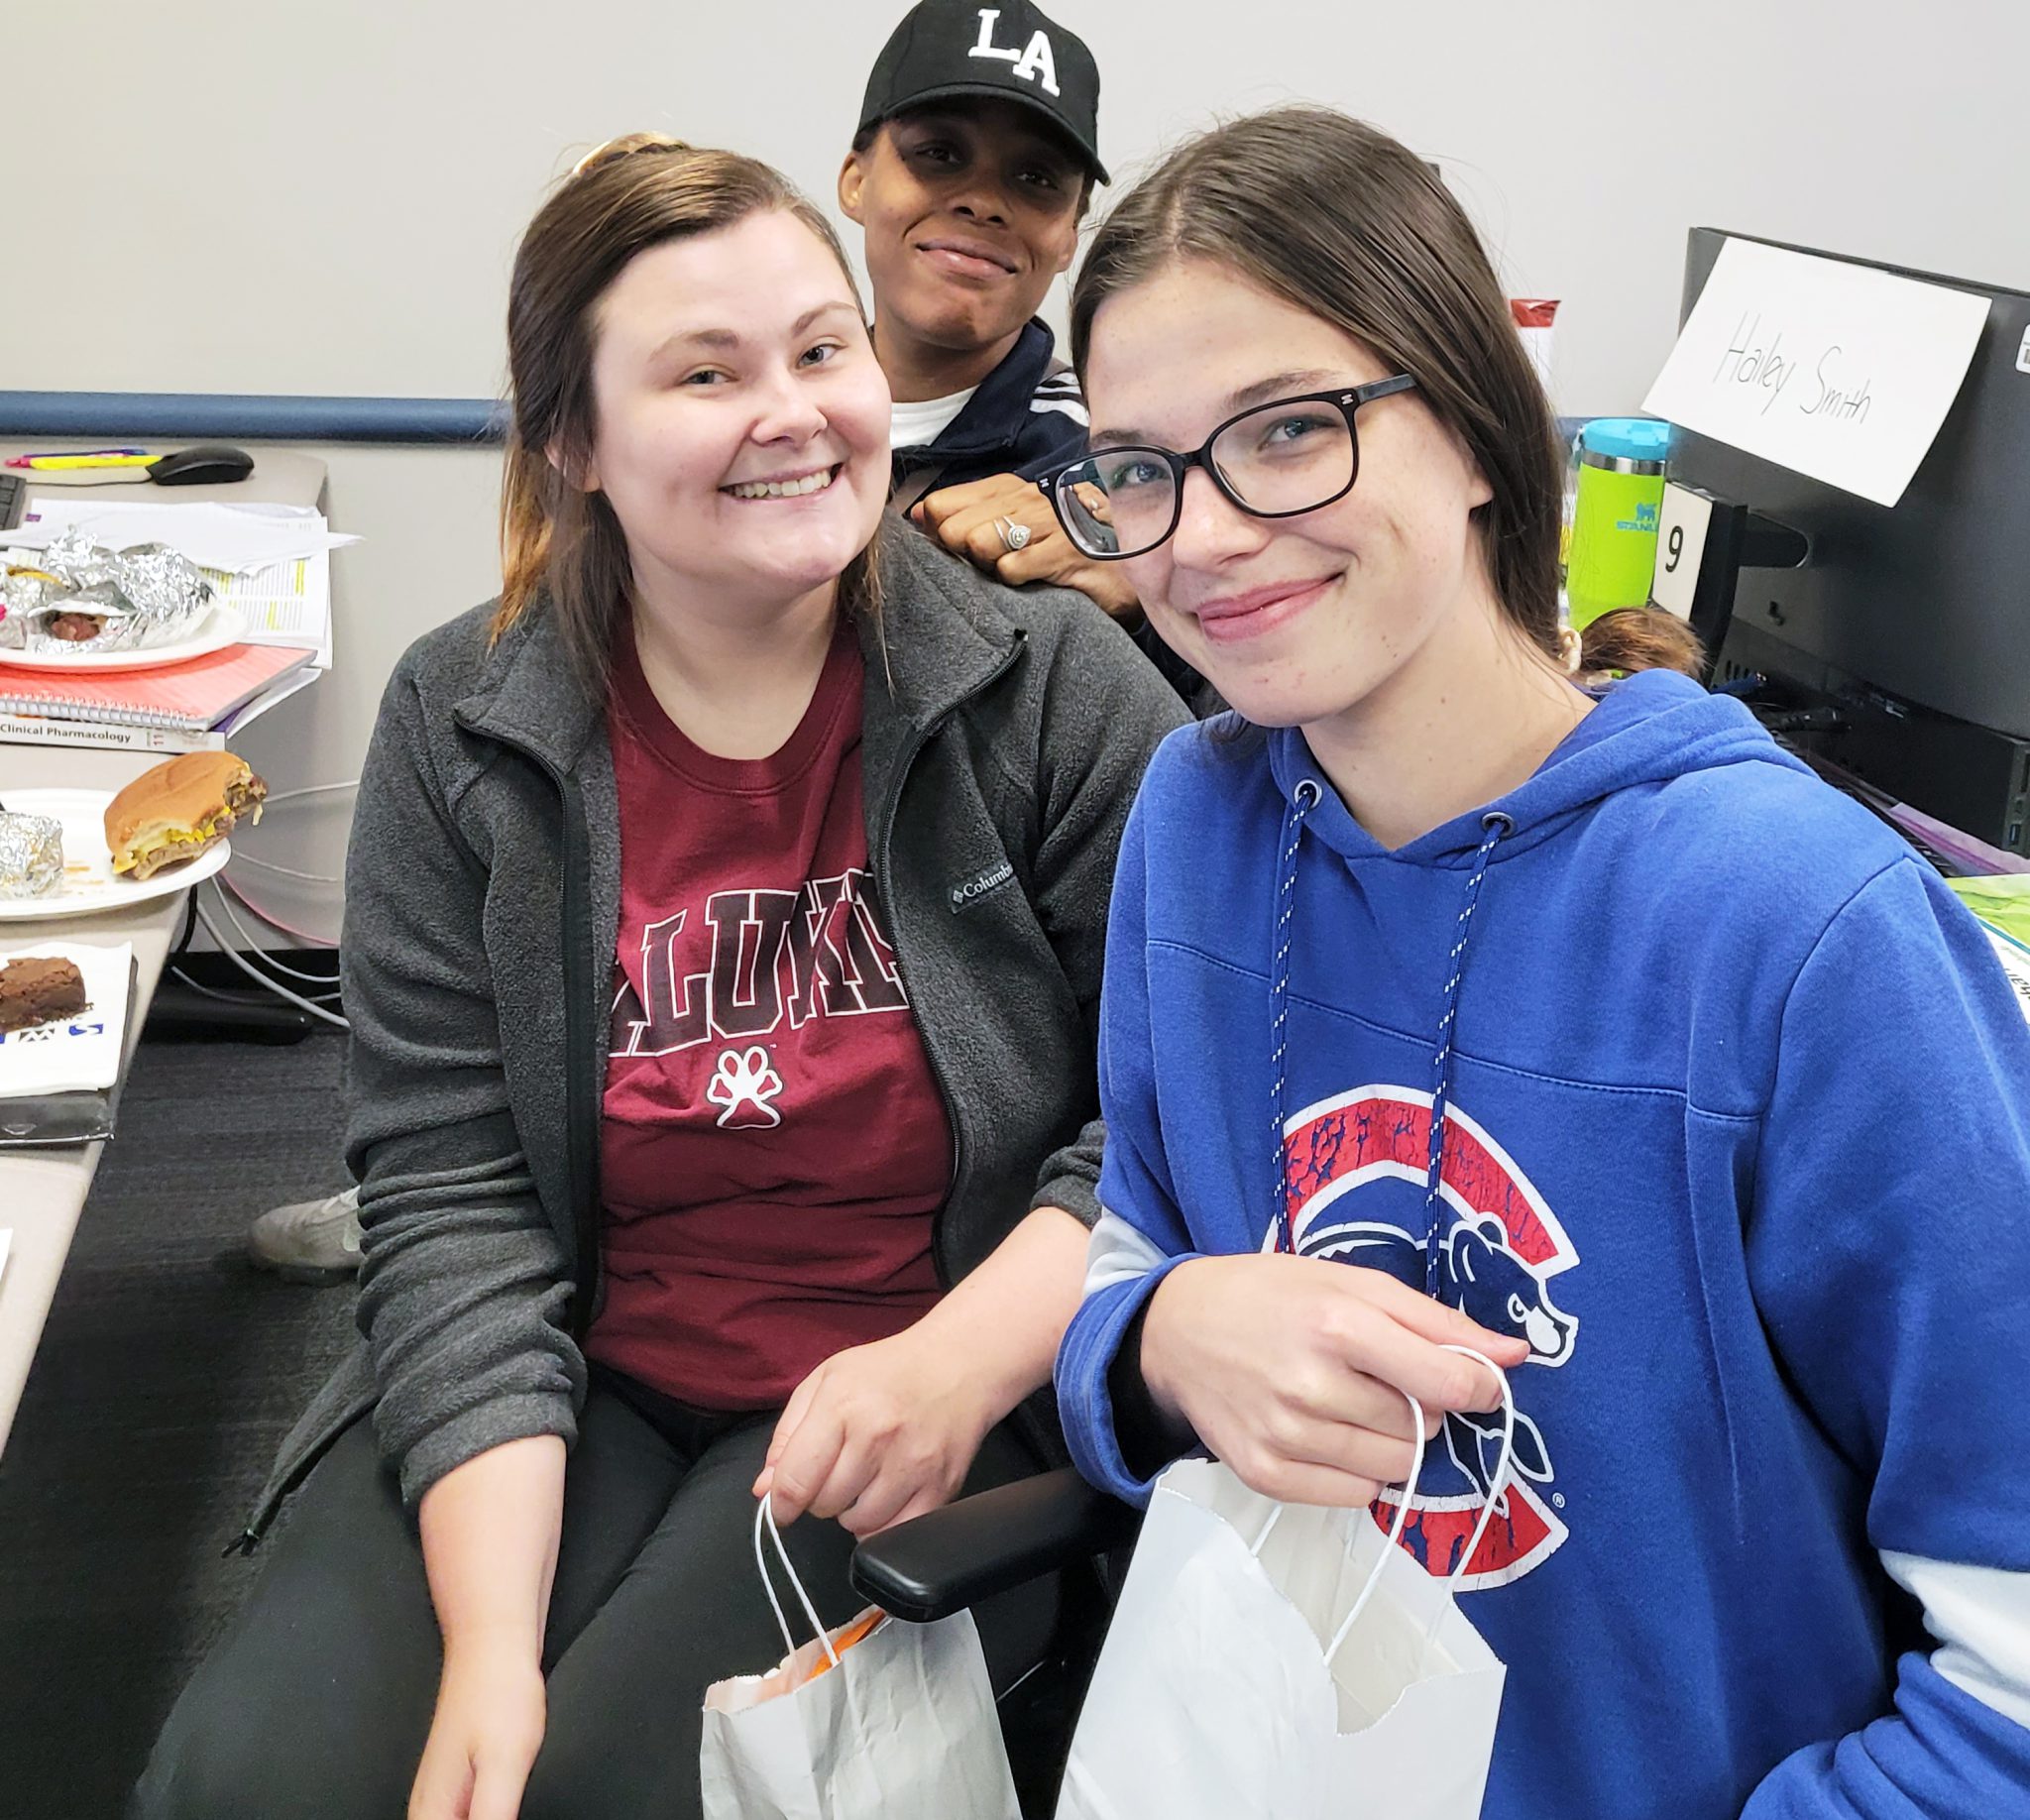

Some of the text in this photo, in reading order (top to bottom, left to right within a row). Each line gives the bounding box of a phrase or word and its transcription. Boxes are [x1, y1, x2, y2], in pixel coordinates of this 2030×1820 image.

[967, 8, 1061, 97] LA
[1712, 310, 1871, 424] Hailey Smith
[1617, 520, 1658, 532] STANL
[1664, 524, 1684, 573] 9
[0, 723, 132, 743] Clinical Pharmacology
[962, 863, 1014, 898] Columb
[607, 868, 911, 1059] LUKI
